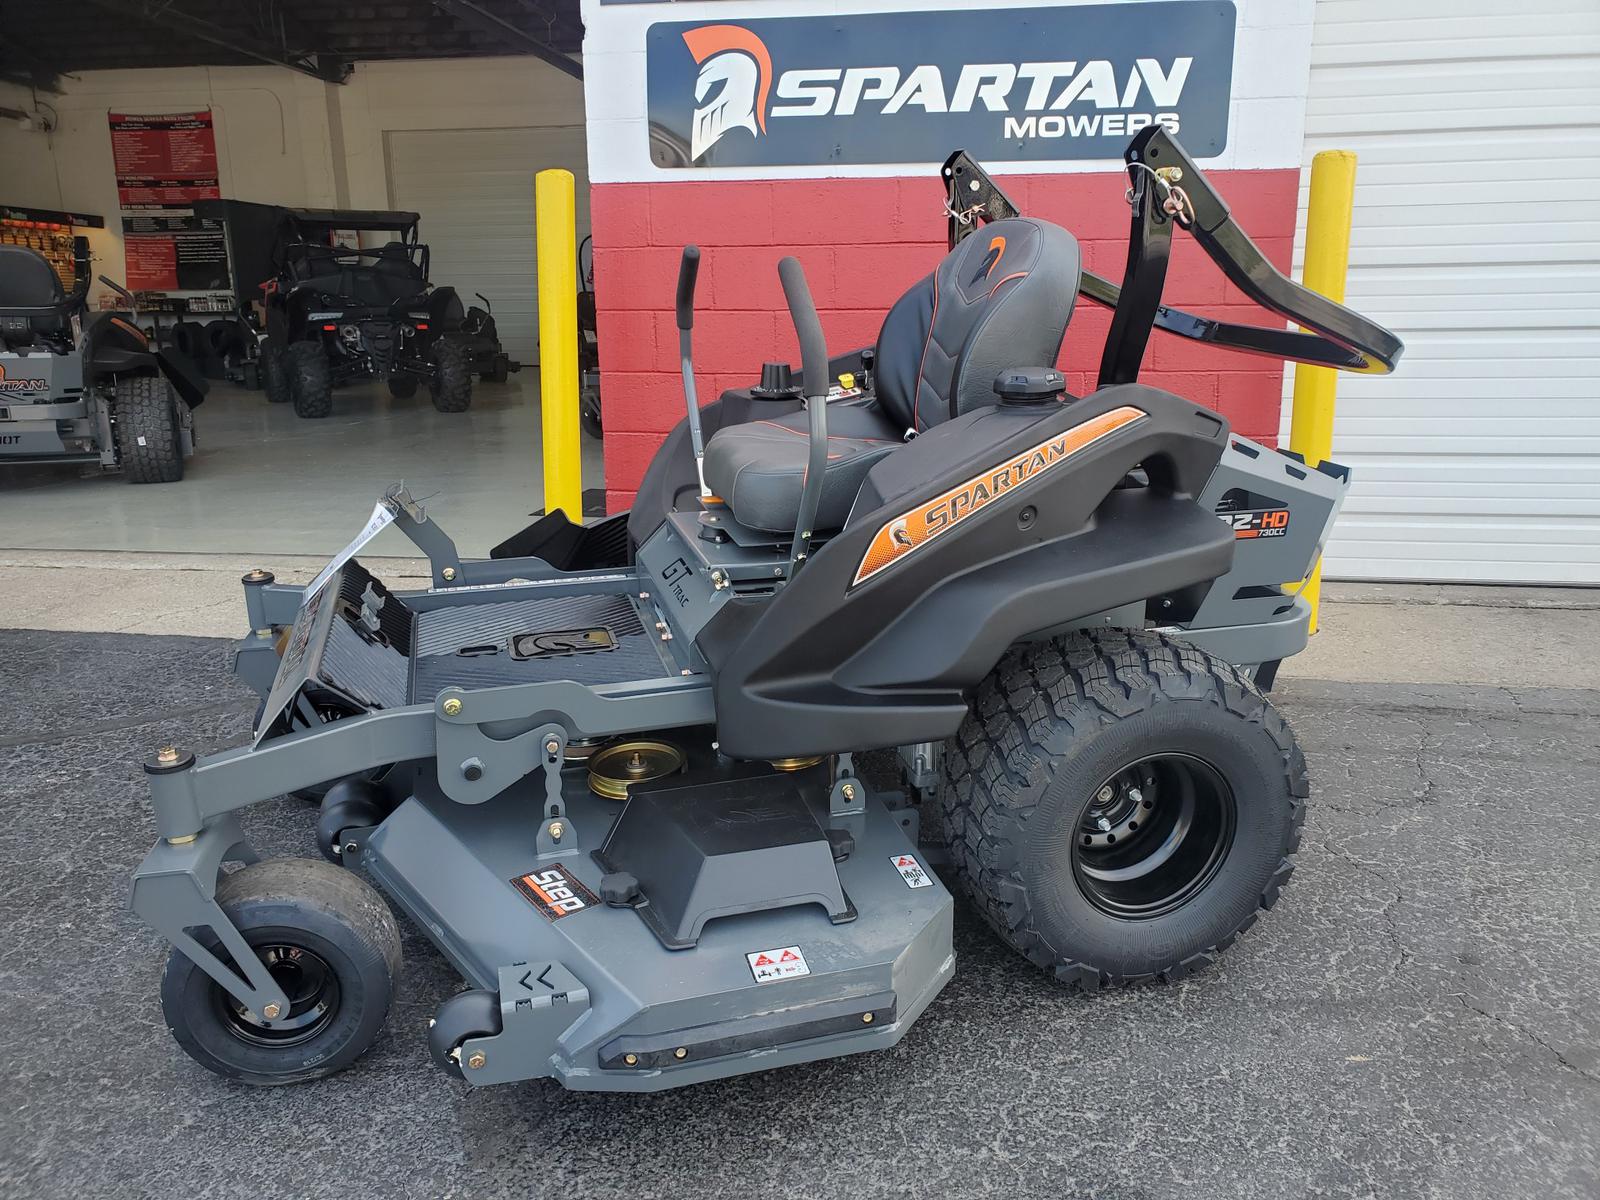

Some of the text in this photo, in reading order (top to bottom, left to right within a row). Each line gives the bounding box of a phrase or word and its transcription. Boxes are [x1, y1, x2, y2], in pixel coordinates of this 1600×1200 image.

[770, 56, 1194, 117] SPARTAN
[1003, 112, 1181, 139] MOWERS
[925, 438, 1068, 535] SPARTAN
[1258, 527, 1286, 537] 730CC
[662, 557, 693, 587] GT
[528, 869, 586, 912] Step
